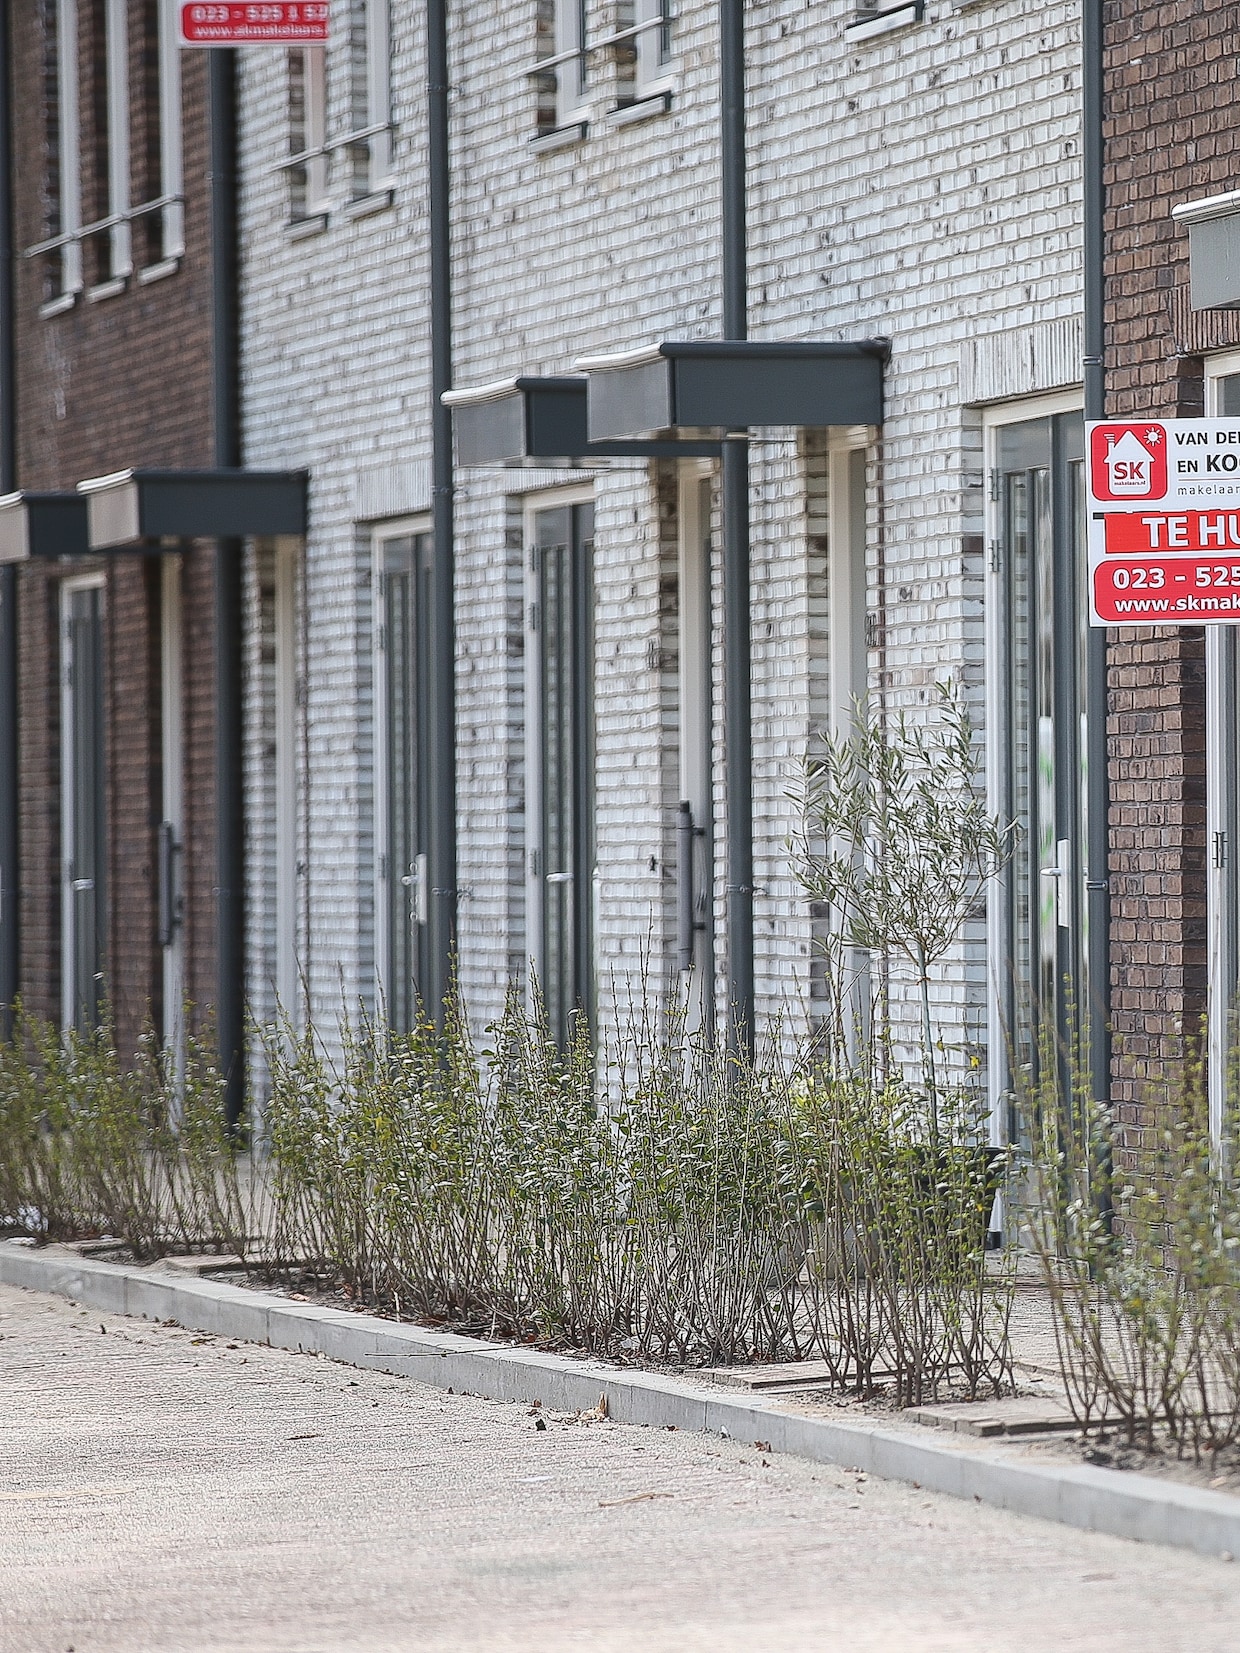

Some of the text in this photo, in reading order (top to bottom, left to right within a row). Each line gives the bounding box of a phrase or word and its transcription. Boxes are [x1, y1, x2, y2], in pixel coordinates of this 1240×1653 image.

[1175, 432, 1208, 445] VAN
[1114, 461, 1145, 480] SK
[1178, 460, 1198, 473] EN
[1141, 514, 1189, 548] TE
[1112, 567, 1166, 590] 023
[1174, 574, 1187, 583] -
